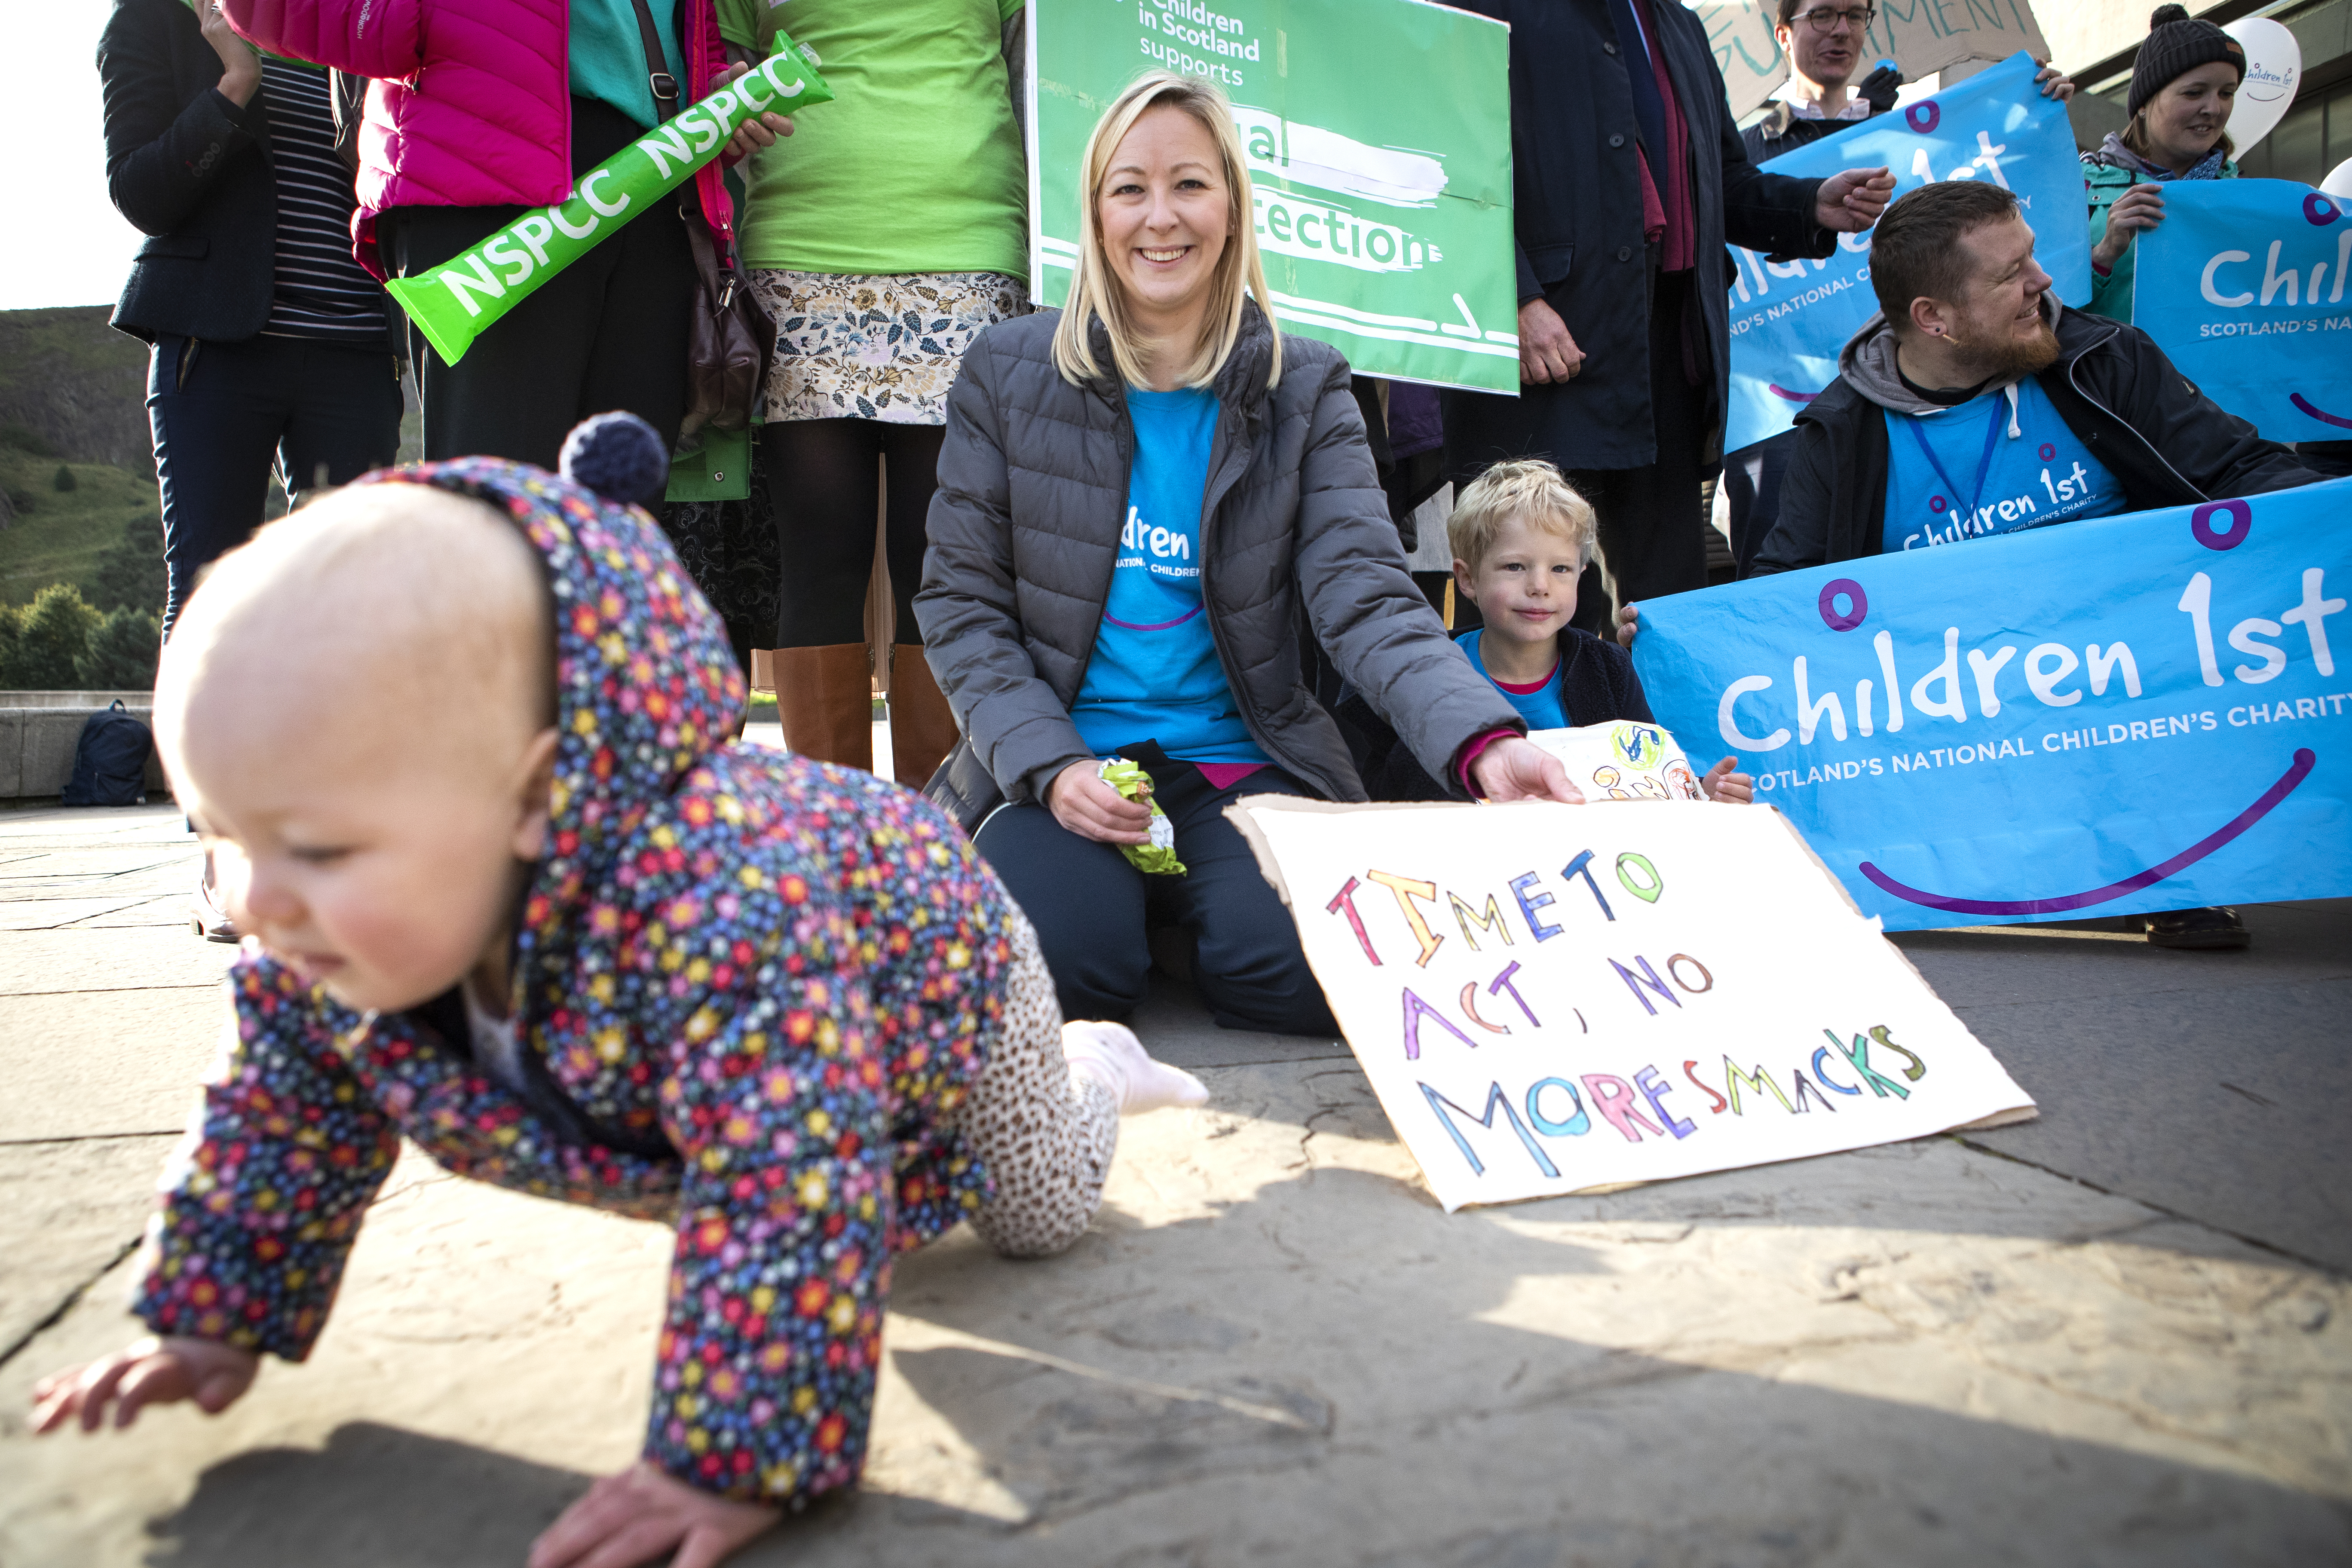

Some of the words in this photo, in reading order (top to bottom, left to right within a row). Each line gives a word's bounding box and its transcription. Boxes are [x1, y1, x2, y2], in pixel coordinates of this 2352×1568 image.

[357, 0, 372, 39] HYDRODOW
[1139, 1, 1157, 30] in
[1162, 12, 1259, 62] Scotland
[1140, 37, 1243, 86] supports
[2244, 68, 2280, 83] hildren
[438, 169, 631, 317] NSPCC
[636, 52, 805, 180] NSPCC
[1767, 277, 1854, 320] NATIONAL
[2200, 319, 2318, 337] SCOTLAND'S
[2040, 461, 2088, 505] 1st
[2008, 510, 2059, 533] CHILDREN'S
[2061, 494, 2096, 514] CHARITY
[1718, 627, 2141, 752] Children
[2177, 568, 2346, 687] 1st
[1892, 738, 2034, 773] NATIONAL
[2042, 711, 2217, 752] CHILDREN'S
[1607, 953, 1713, 1016] NO
